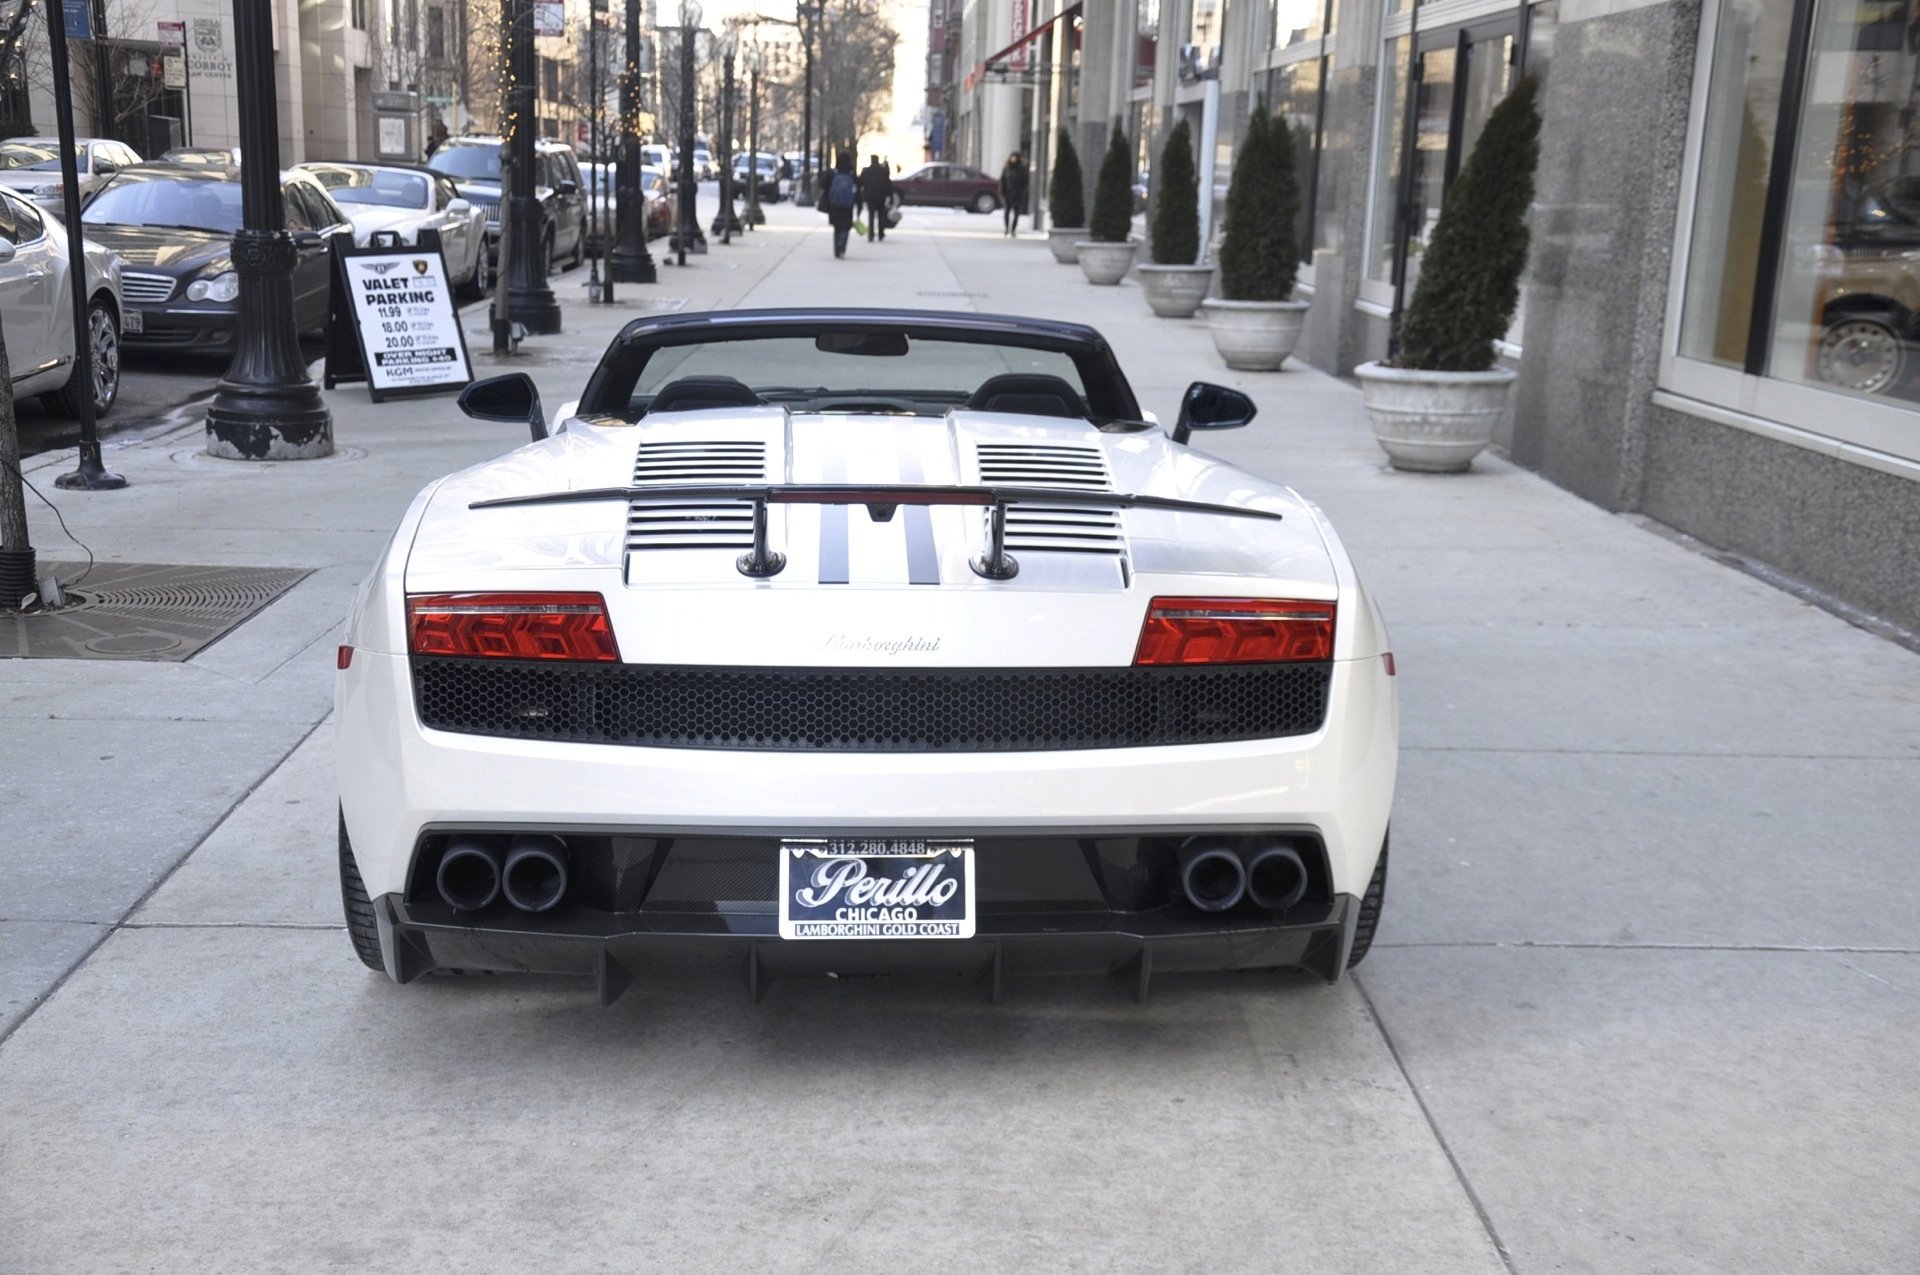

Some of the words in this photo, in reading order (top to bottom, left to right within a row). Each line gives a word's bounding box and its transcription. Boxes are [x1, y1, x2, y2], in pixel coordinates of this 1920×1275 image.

[362, 278, 409, 290] VALET
[366, 291, 435, 305] PARKING
[378, 307, 402, 318] 11.99
[382, 321, 409, 333] 18.00
[385, 335, 414, 348] 20.00
[383, 351, 412, 359] OVER
[386, 367, 414, 377] KGM
[824, 633, 941, 656] Lamborghini
[829, 842, 926, 855] 312.280.4848
[795, 857, 958, 908] Perillo
[835, 907, 918, 922] CHICAGO
[796, 924, 880, 936] LAMBORGHINI
[882, 923, 917, 936] GOLD
[919, 923, 959, 936] COAST
